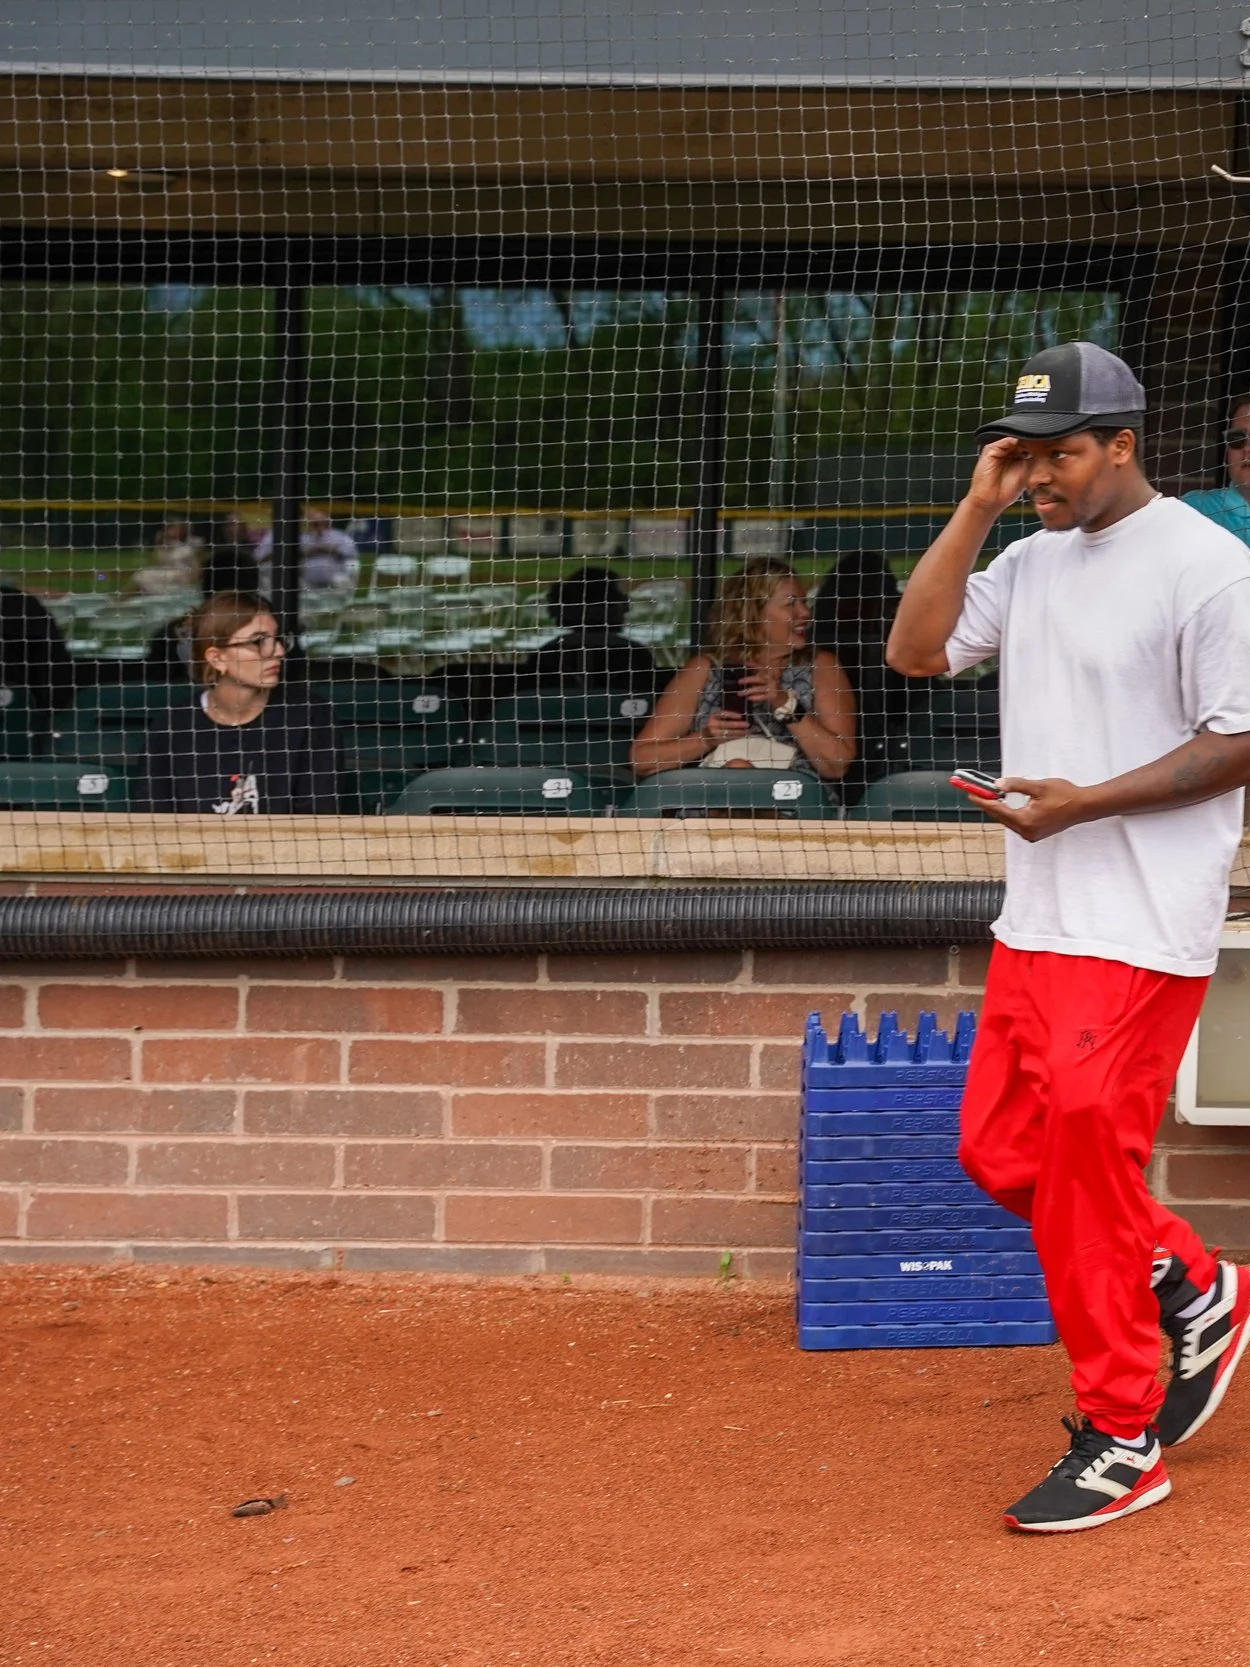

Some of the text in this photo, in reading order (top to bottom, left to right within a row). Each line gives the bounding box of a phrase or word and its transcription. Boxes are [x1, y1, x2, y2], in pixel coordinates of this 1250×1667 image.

[895, 1069, 965, 1082] PEPSI-CO
[892, 1093, 964, 1105] PEPSI-CO
[891, 1117, 961, 1129] PEPSI-CO
[889, 1141, 961, 1153] PEPSI-CO
[890, 1165, 963, 1177] PEPSI-CO
[888, 1211, 977, 1224] PEPSI-COLA
[888, 1235, 977, 1248] PEPSI-COLA
[886, 1306, 974, 1320] PEPSI-COLA
[886, 1330, 974, 1344] PEPSI-COLA
